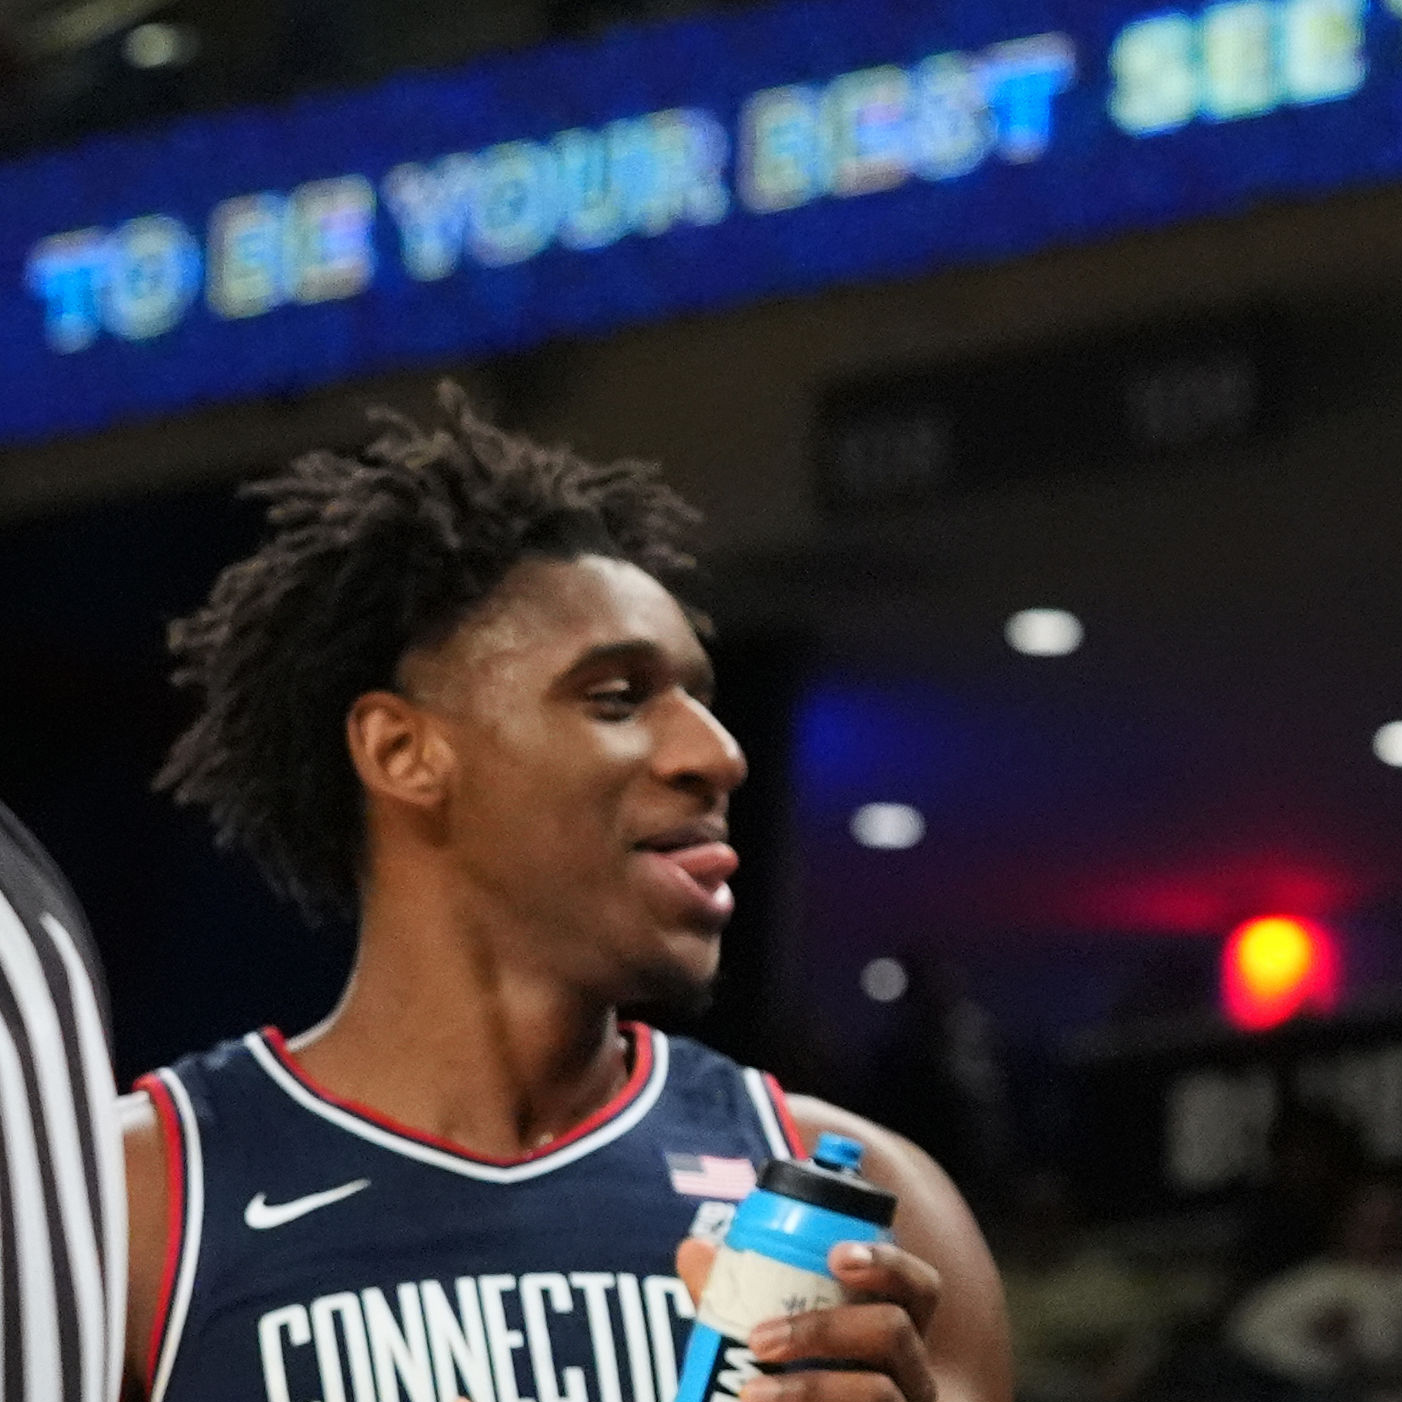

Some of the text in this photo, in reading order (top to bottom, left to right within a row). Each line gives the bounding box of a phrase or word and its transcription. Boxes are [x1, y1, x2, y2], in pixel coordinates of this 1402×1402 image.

[26, 212, 200, 354] TO
[206, 174, 376, 321] BE
[381, 107, 730, 283] YOUR
[737, 32, 1076, 217] BEST
[1109, 0, 1367, 137] SEE
